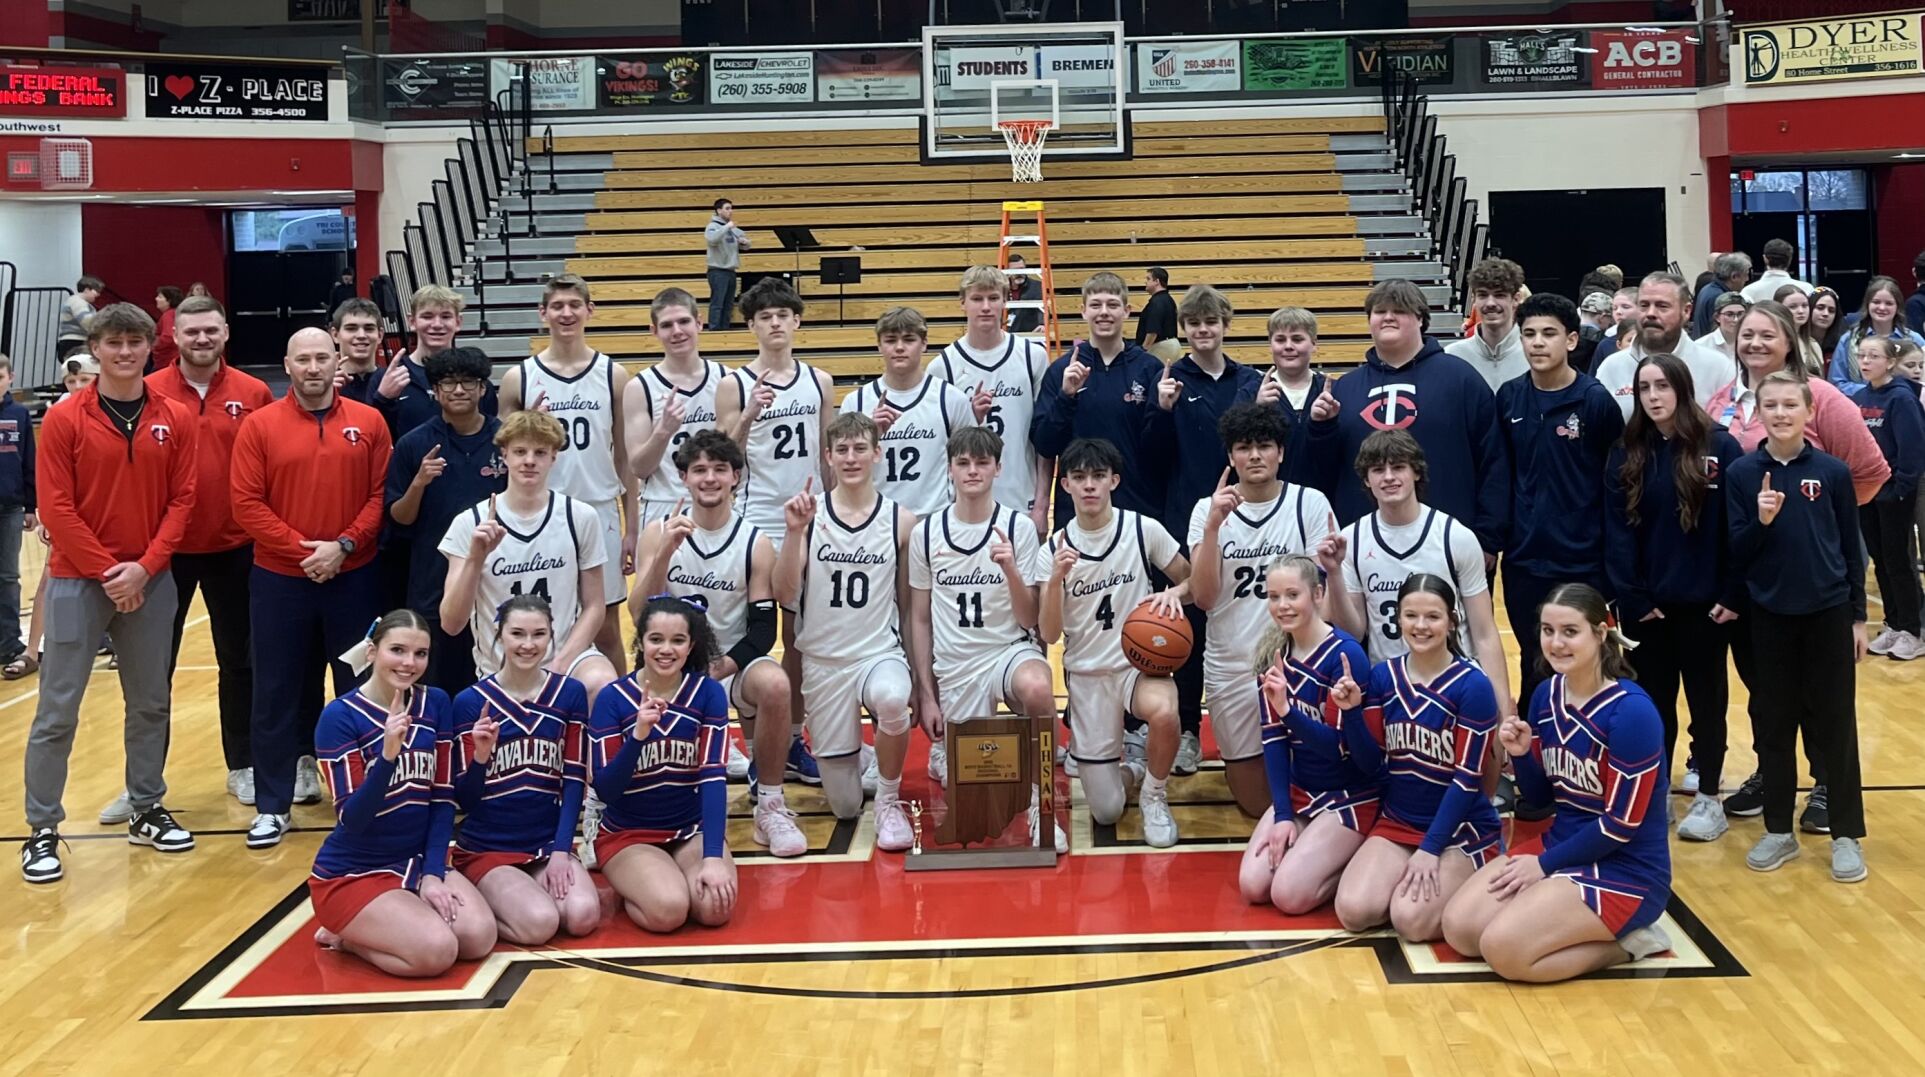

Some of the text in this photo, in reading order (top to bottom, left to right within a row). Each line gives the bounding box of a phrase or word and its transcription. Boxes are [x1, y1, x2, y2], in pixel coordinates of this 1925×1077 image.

[1788, 18, 1909, 50] DYER
[1603, 40, 1682, 67] ACB
[1780, 42, 1918, 60] HEALTH WELLNESS
[615, 61, 648, 80] GO
[662, 57, 700, 72] WINGS
[715, 59, 808, 69] LAKESIDE CHEVROLET
[957, 61, 1028, 76] STUDENTS
[1051, 59, 1113, 71] BREMEN
[1183, 59, 1235, 69] 260-358-4141
[1487, 65, 1578, 76] LAWN & LANDSCAPE
[1819, 55, 1875, 67] CENTER
[1875, 61, 1917, 73] 356-1616
[531, 72, 579, 85] SURANCE
[1603, 70, 1682, 80] GENERAL CONTRACTOR
[1798, 68, 1822, 77] Home
[1823, 66, 1849, 76] Street
[10, 74, 105, 92] FEDERAL
[148, 75, 158, 97] I
[199, 75, 222, 103] Z
[242, 79, 323, 101] PLACE
[605, 80, 659, 92] VIKINGS!
[717, 82, 807, 98] (260) 355-5908
[1149, 79, 1180, 87] UNITED
[60, 92, 114, 106] BANK
[171, 106, 306, 117] Z-PLACE PIZZA 356-4500
[986, 404, 1005, 438] 5
[772, 421, 809, 460] 21
[879, 422, 937, 441] avaliers
[886, 446, 921, 482] 12
[817, 543, 887, 565] Cavaliers
[1223, 539, 1289, 560] Cavaliers
[492, 552, 566, 577] Cavaliers
[667, 565, 737, 592] Cavaliers
[936, 566, 1004, 586] Cavaliers
[1072, 569, 1136, 598] Cavaliers
[830, 569, 869, 609] 10
[956, 592, 984, 629] 11
[1095, 594, 1116, 631] 4
[1385, 722, 1455, 765] AVALIERS
[1040, 731, 1053, 815] IHSAA
